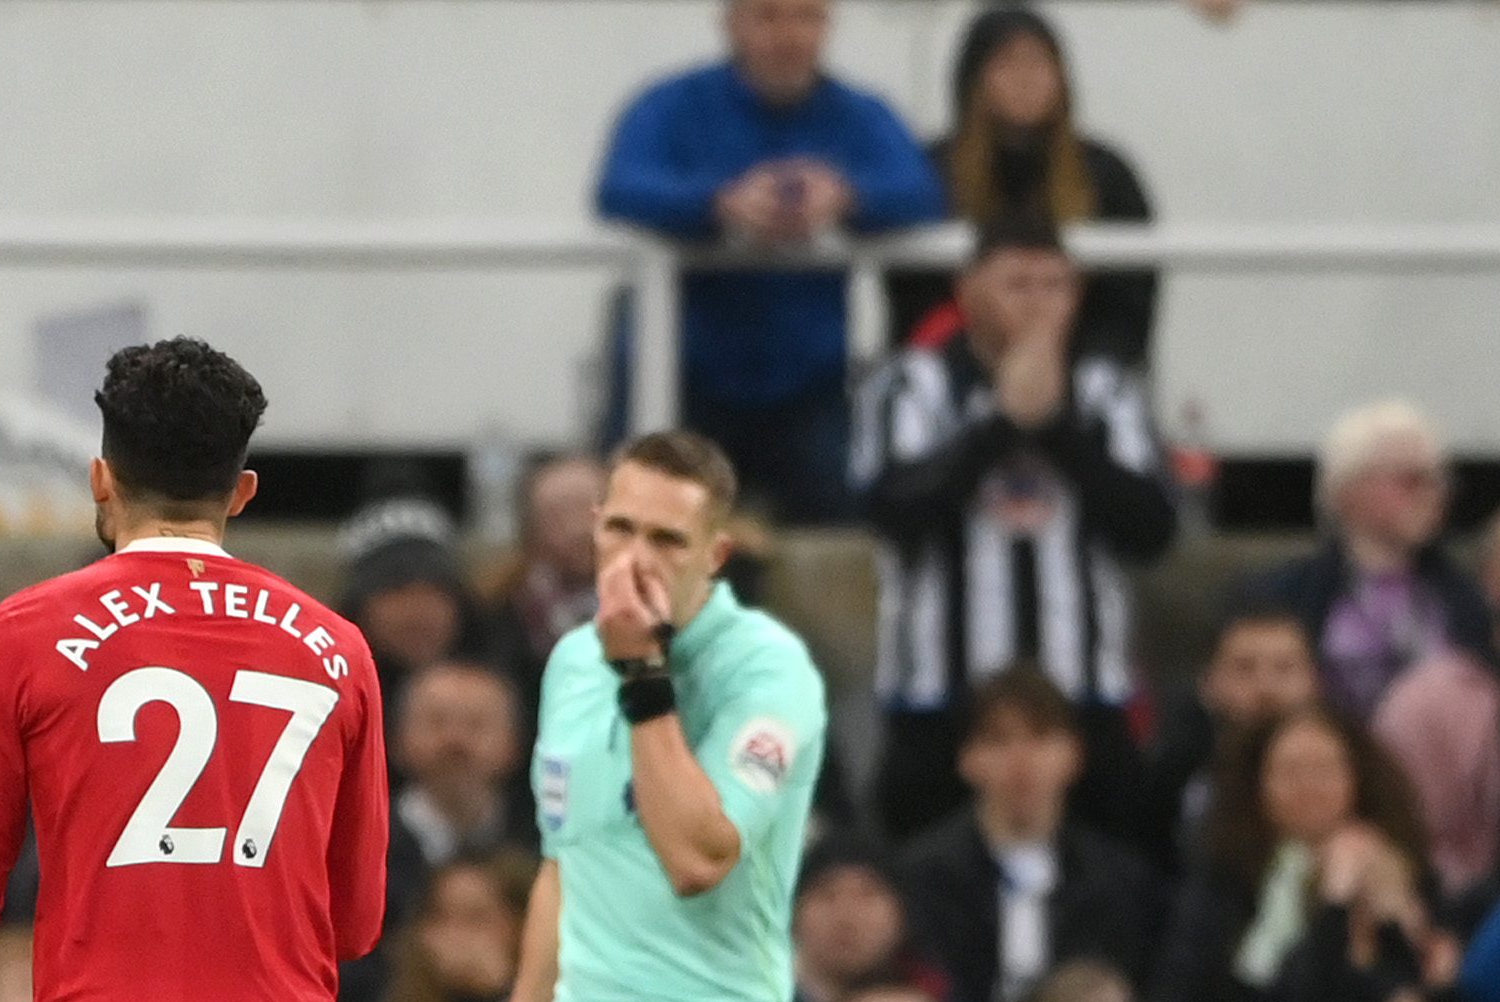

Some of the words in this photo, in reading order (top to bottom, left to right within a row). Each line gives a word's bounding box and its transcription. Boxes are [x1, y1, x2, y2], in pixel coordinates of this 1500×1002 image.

[55, 582, 175, 672] ALEX
[189, 581, 349, 681] TELLES
[96, 666, 340, 868] 27
